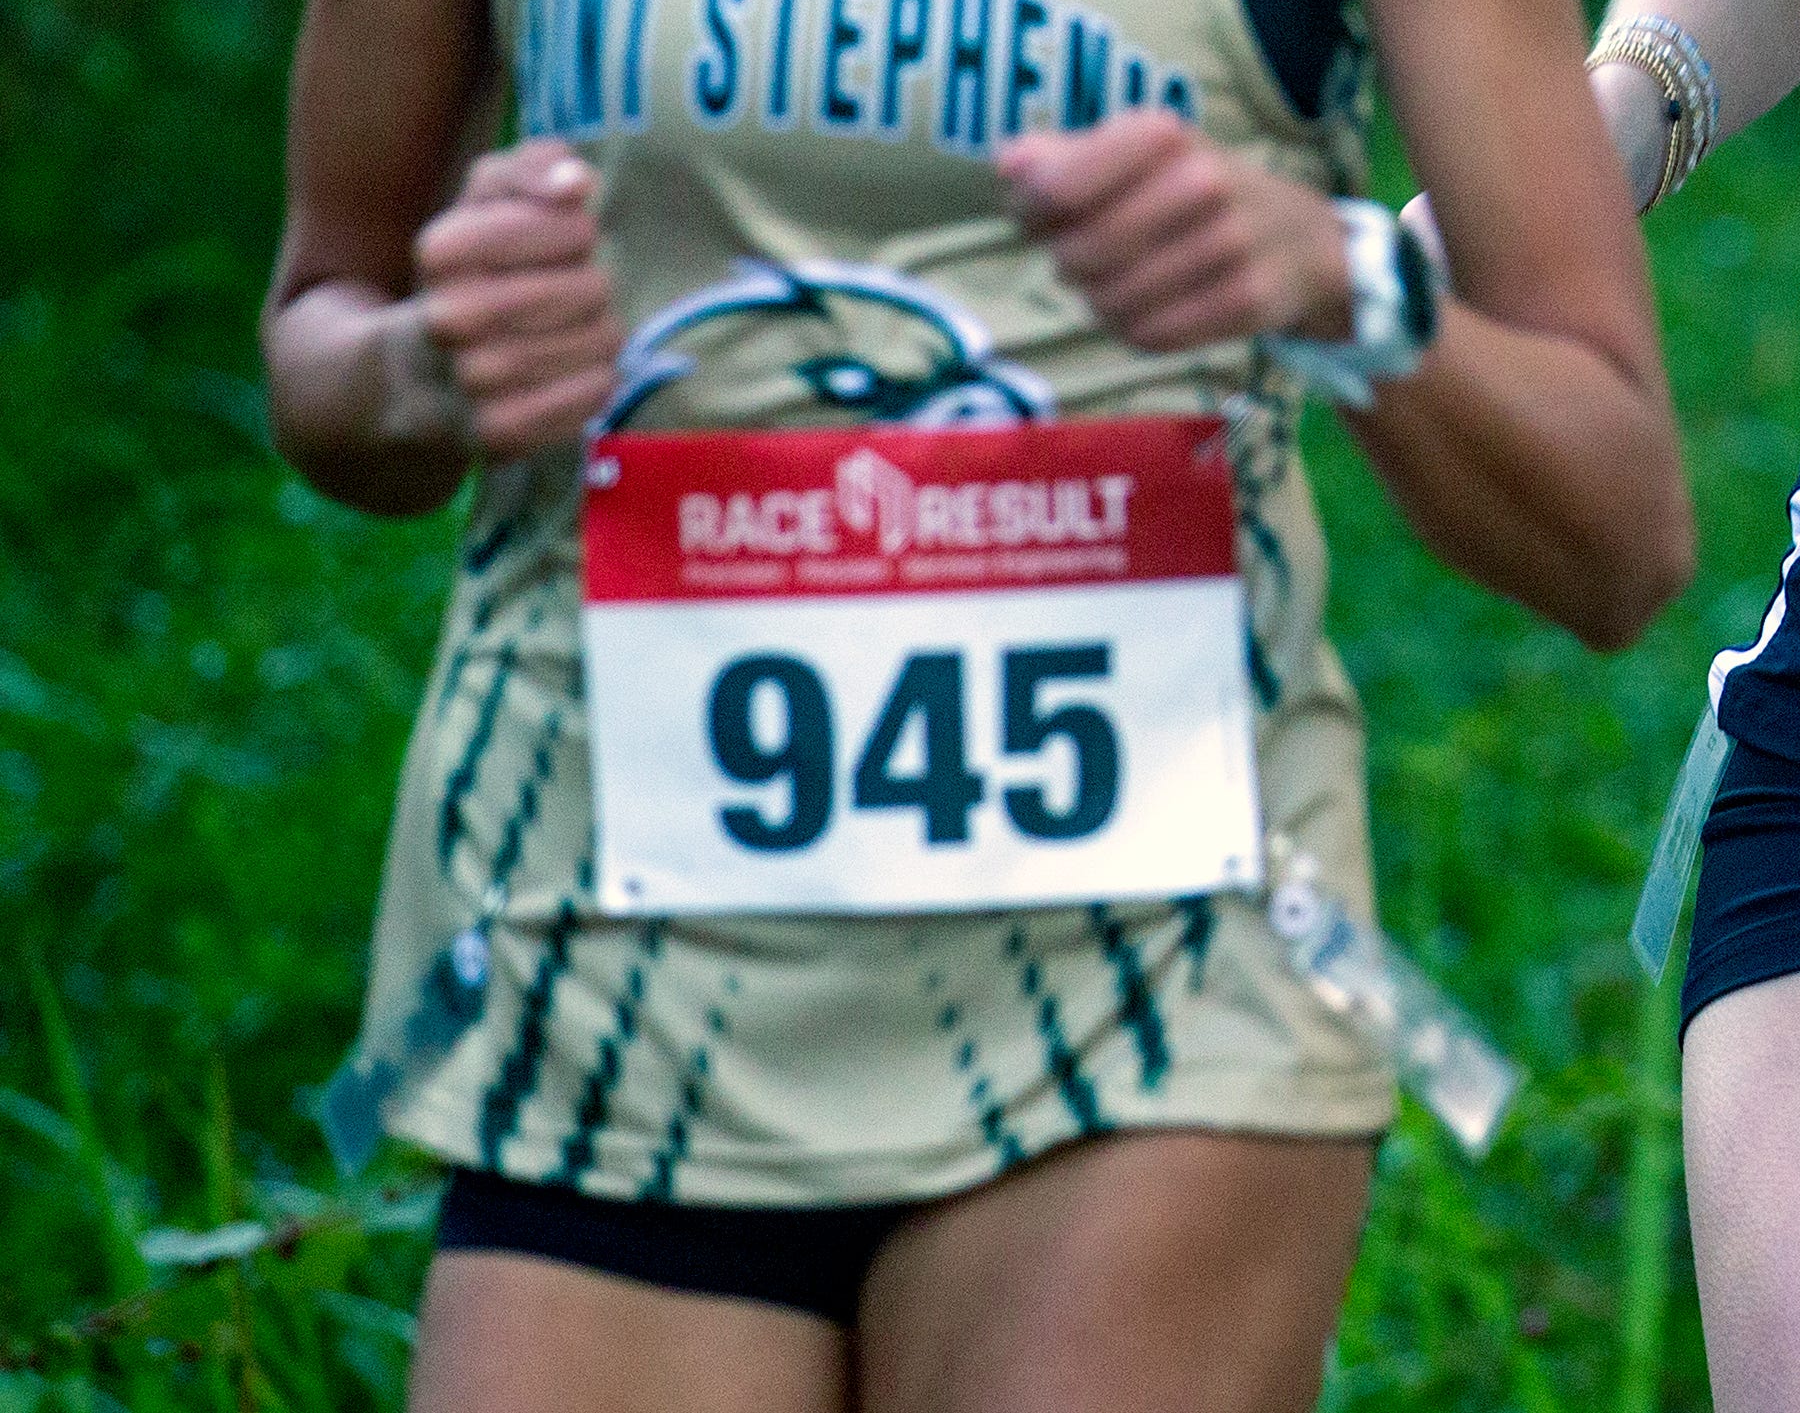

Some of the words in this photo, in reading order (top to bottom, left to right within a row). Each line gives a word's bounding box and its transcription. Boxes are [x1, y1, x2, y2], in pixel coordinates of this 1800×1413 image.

[676, 488, 838, 555] RACE
[912, 474, 1135, 550] RESULT
[707, 642, 1120, 852] 945
